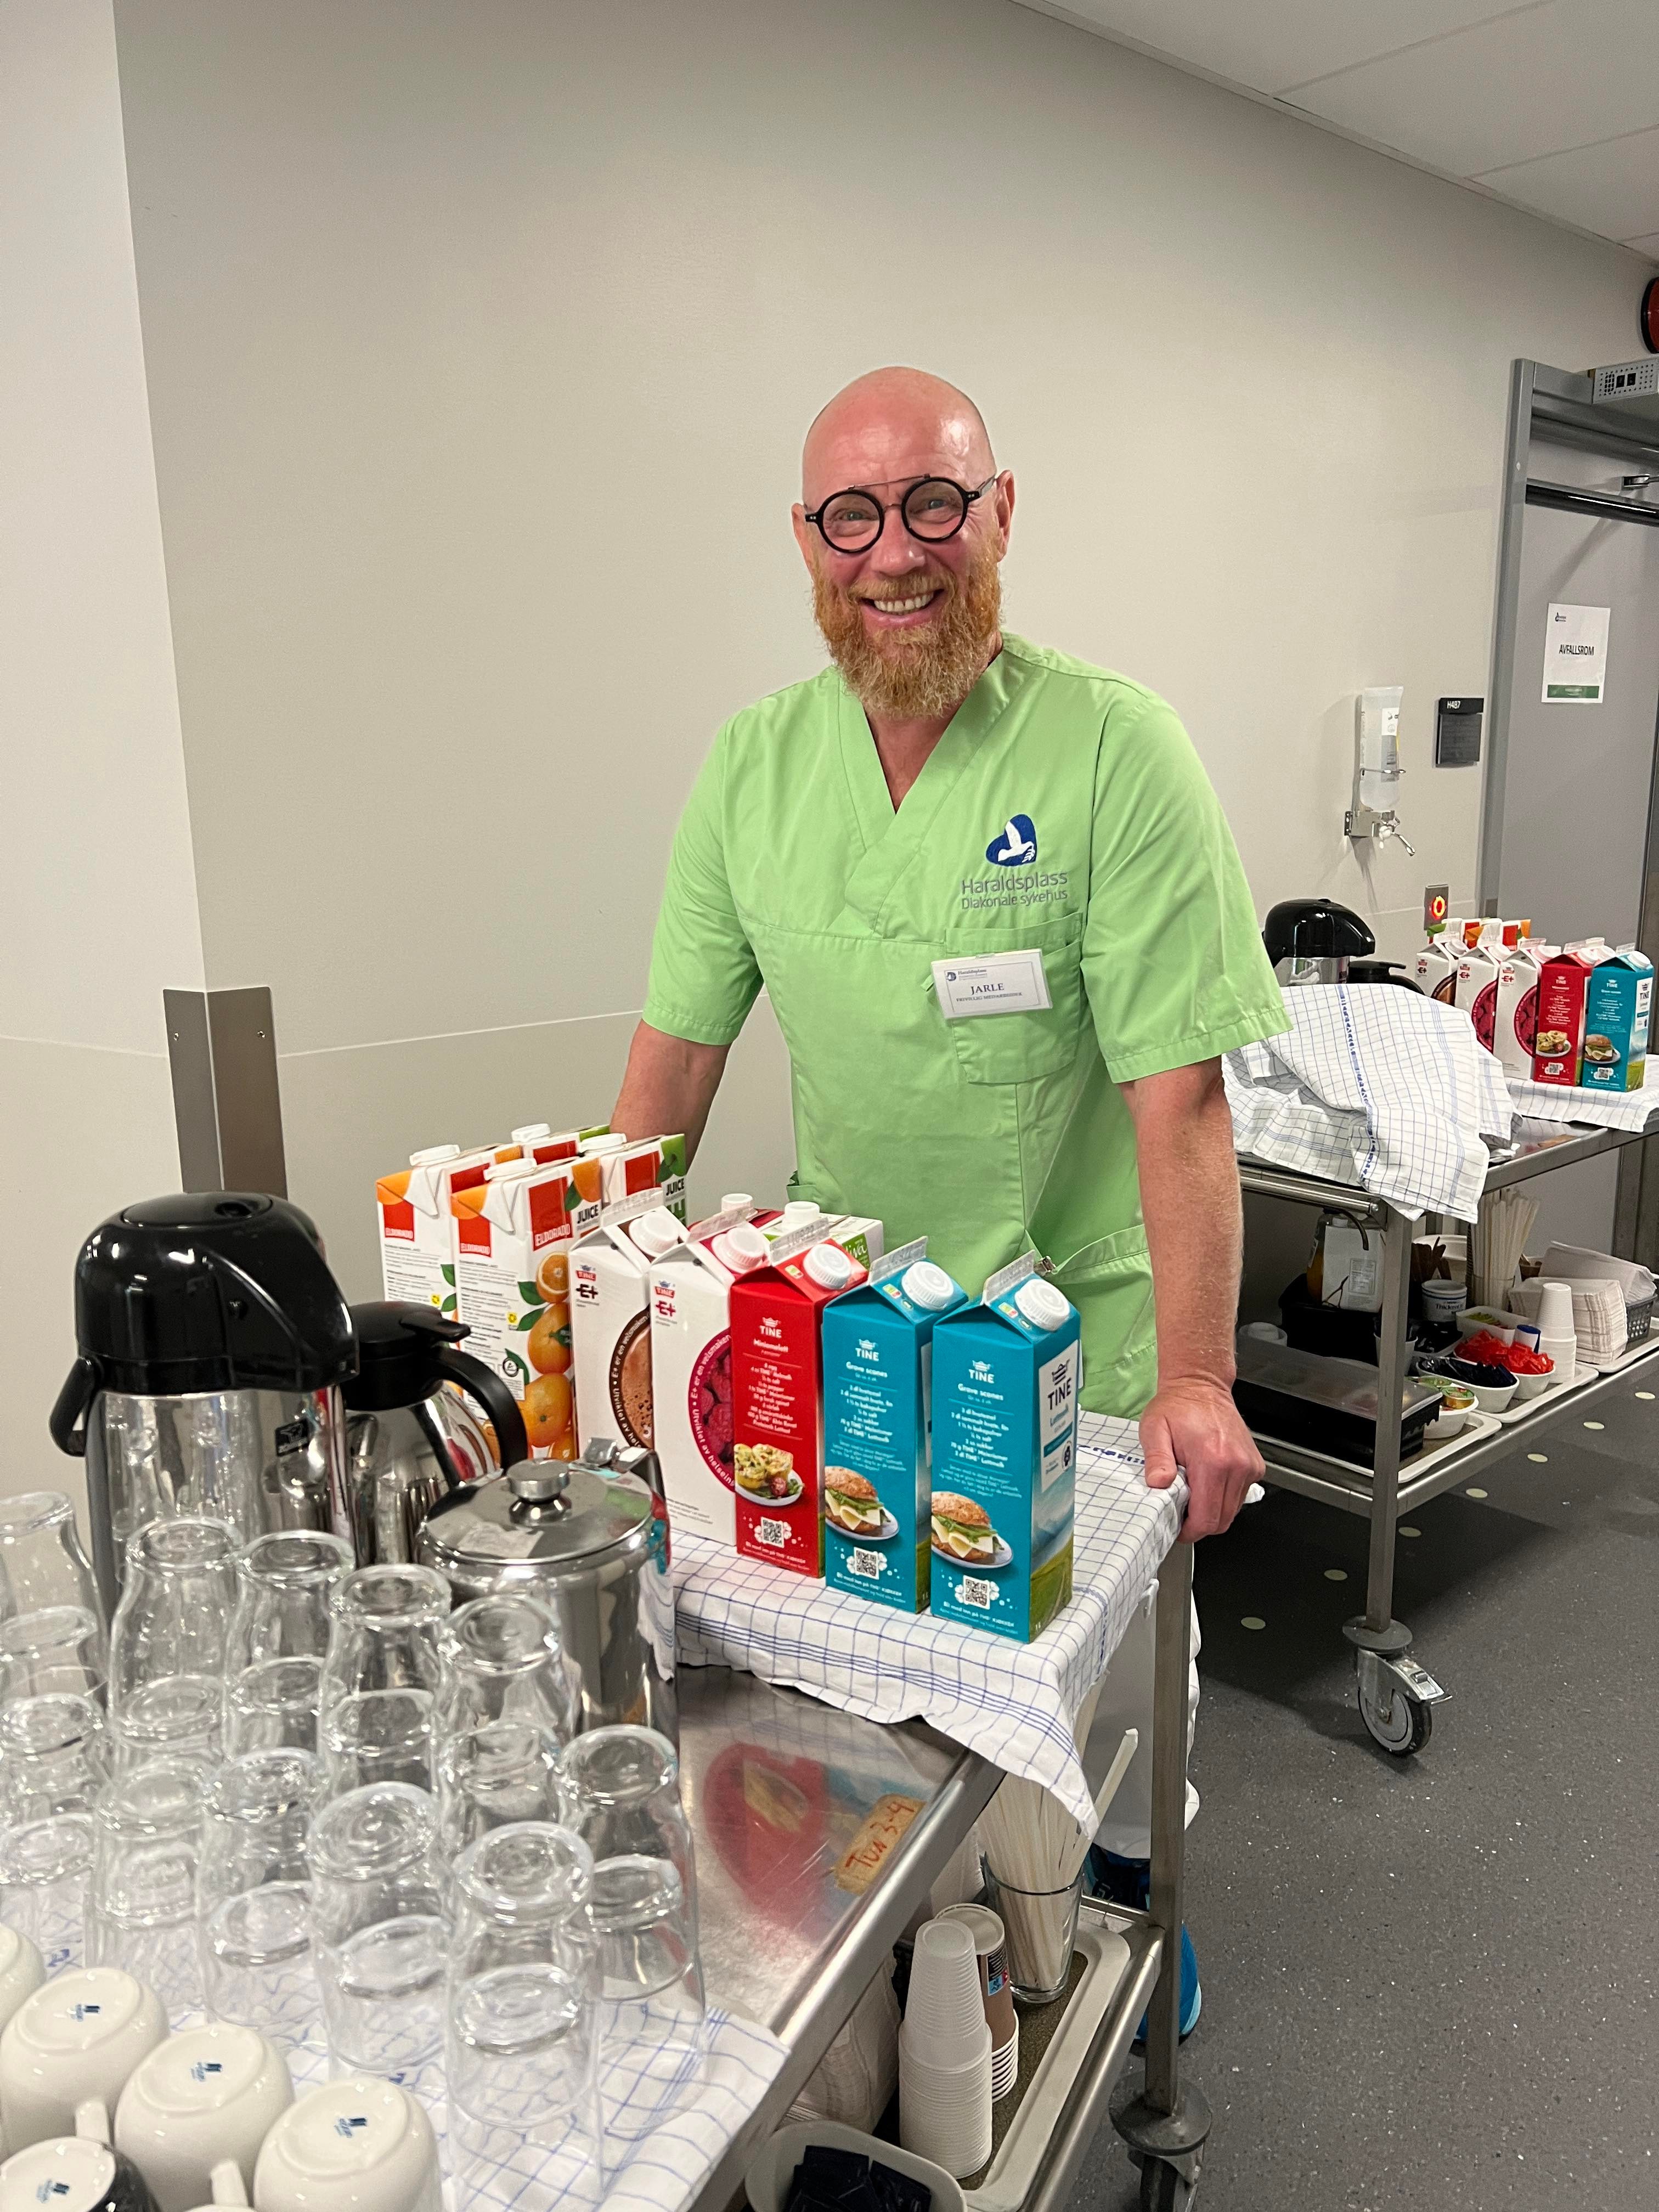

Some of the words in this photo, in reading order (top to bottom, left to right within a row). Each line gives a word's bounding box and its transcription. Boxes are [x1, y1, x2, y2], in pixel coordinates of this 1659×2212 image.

[1559, 644, 1594, 656] AVFALLSROM
[961, 871, 1068, 895] Haraldsplass
[961, 895, 1018, 910] Diakonale
[1020, 889, 1068, 906] sykehus
[970, 983, 1005, 995] JARLE
[666, 1178, 685, 1196] JUICE
[577, 1204, 599, 1224] JUICE
[759, 1325, 782, 1339] TINE
[855, 1347, 879, 1362] TINE
[969, 1369, 995, 1384] TINE
[1047, 1377, 1071, 1410] TINE
